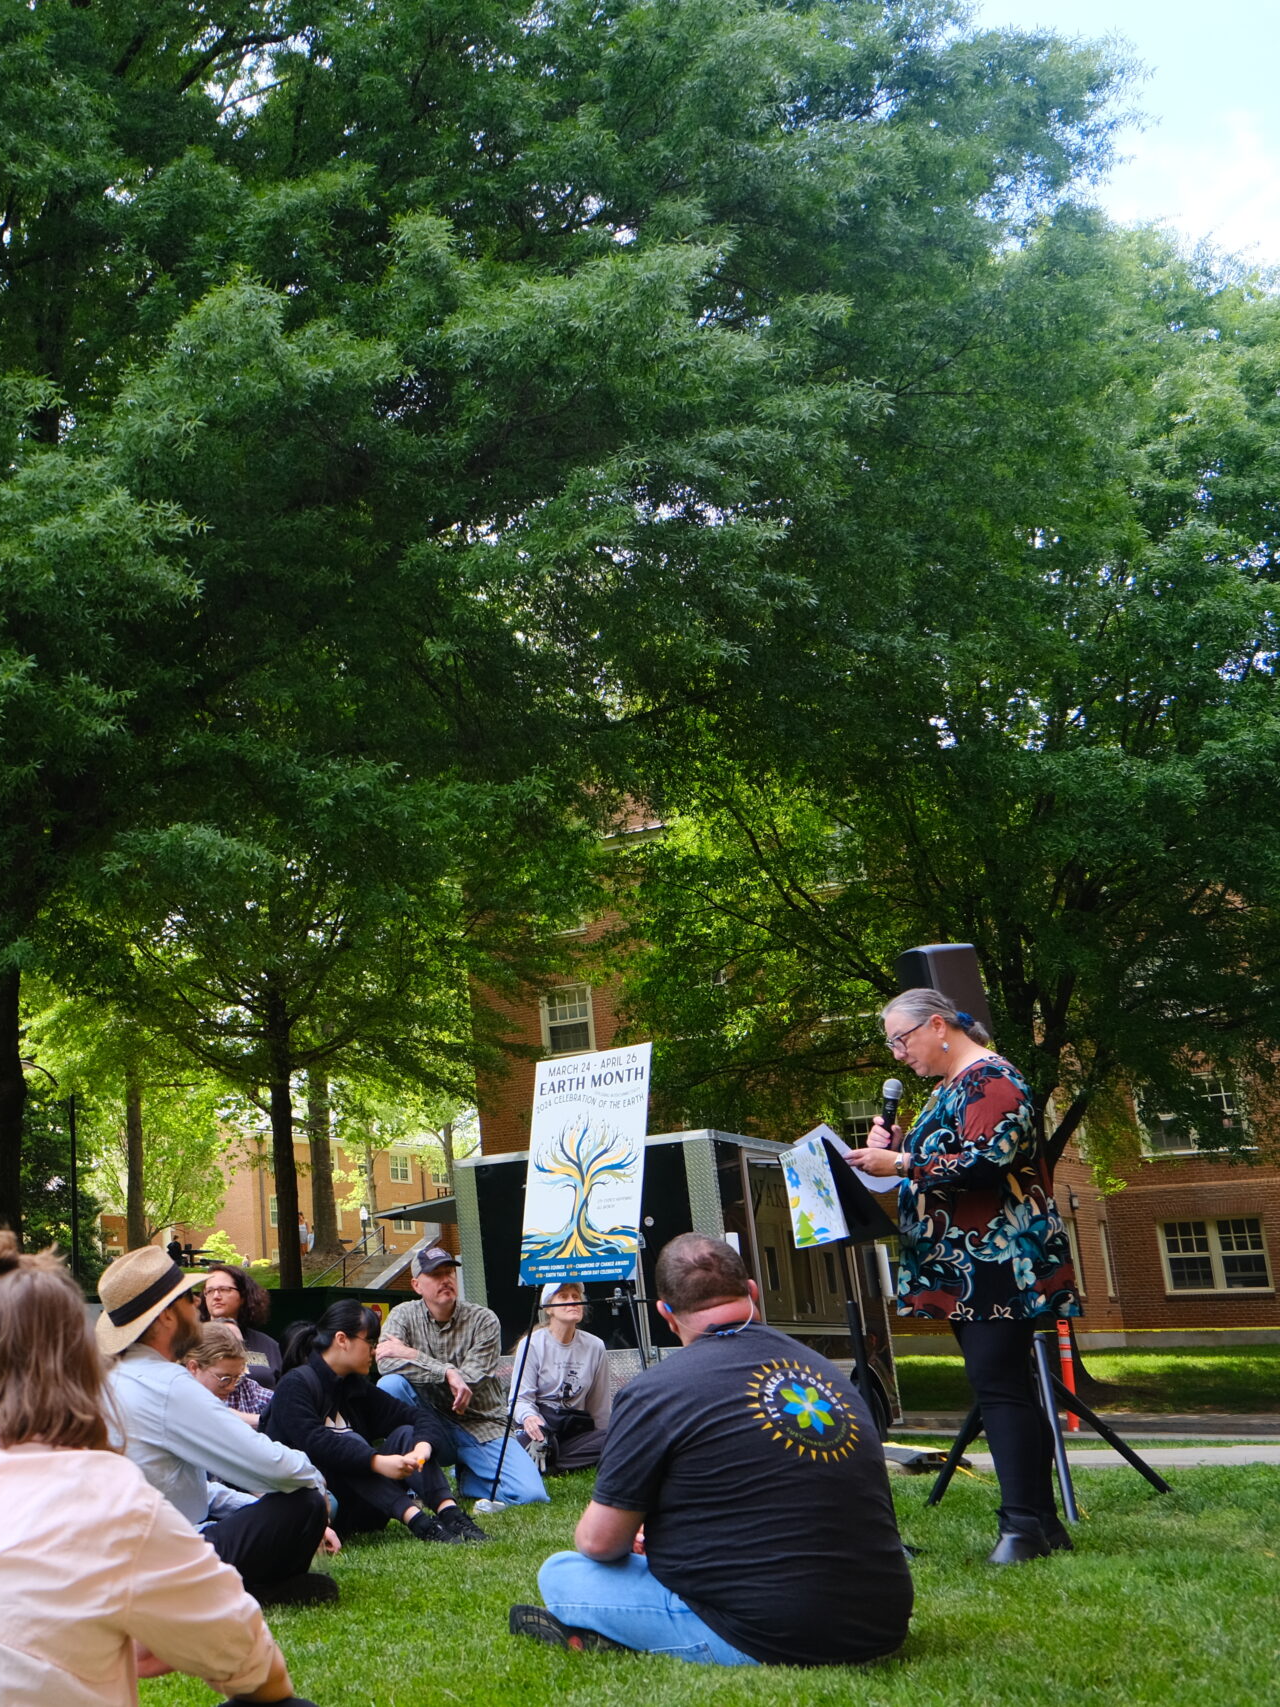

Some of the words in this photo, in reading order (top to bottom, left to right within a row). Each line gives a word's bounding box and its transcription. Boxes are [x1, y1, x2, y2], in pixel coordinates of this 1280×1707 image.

[548, 1063, 578, 1077] MARCH
[581, 1061, 591, 1072] 24
[600, 1056, 623, 1069] APRIL
[626, 1053, 637, 1064] 26
[539, 1076, 585, 1096] EARTH
[590, 1066, 645, 1089] MONTH
[536, 1101, 552, 1114] 2024
[554, 1093, 596, 1106] CELEBRATION
[598, 1100, 608, 1109] OF
[609, 1100, 620, 1109] THE
[622, 1093, 645, 1109] EARTH
[788, 1370, 798, 1379] A
[763, 1372, 785, 1404] TAKES
[800, 1372, 844, 1412] FOREST
[766, 1406, 781, 1419] IT
